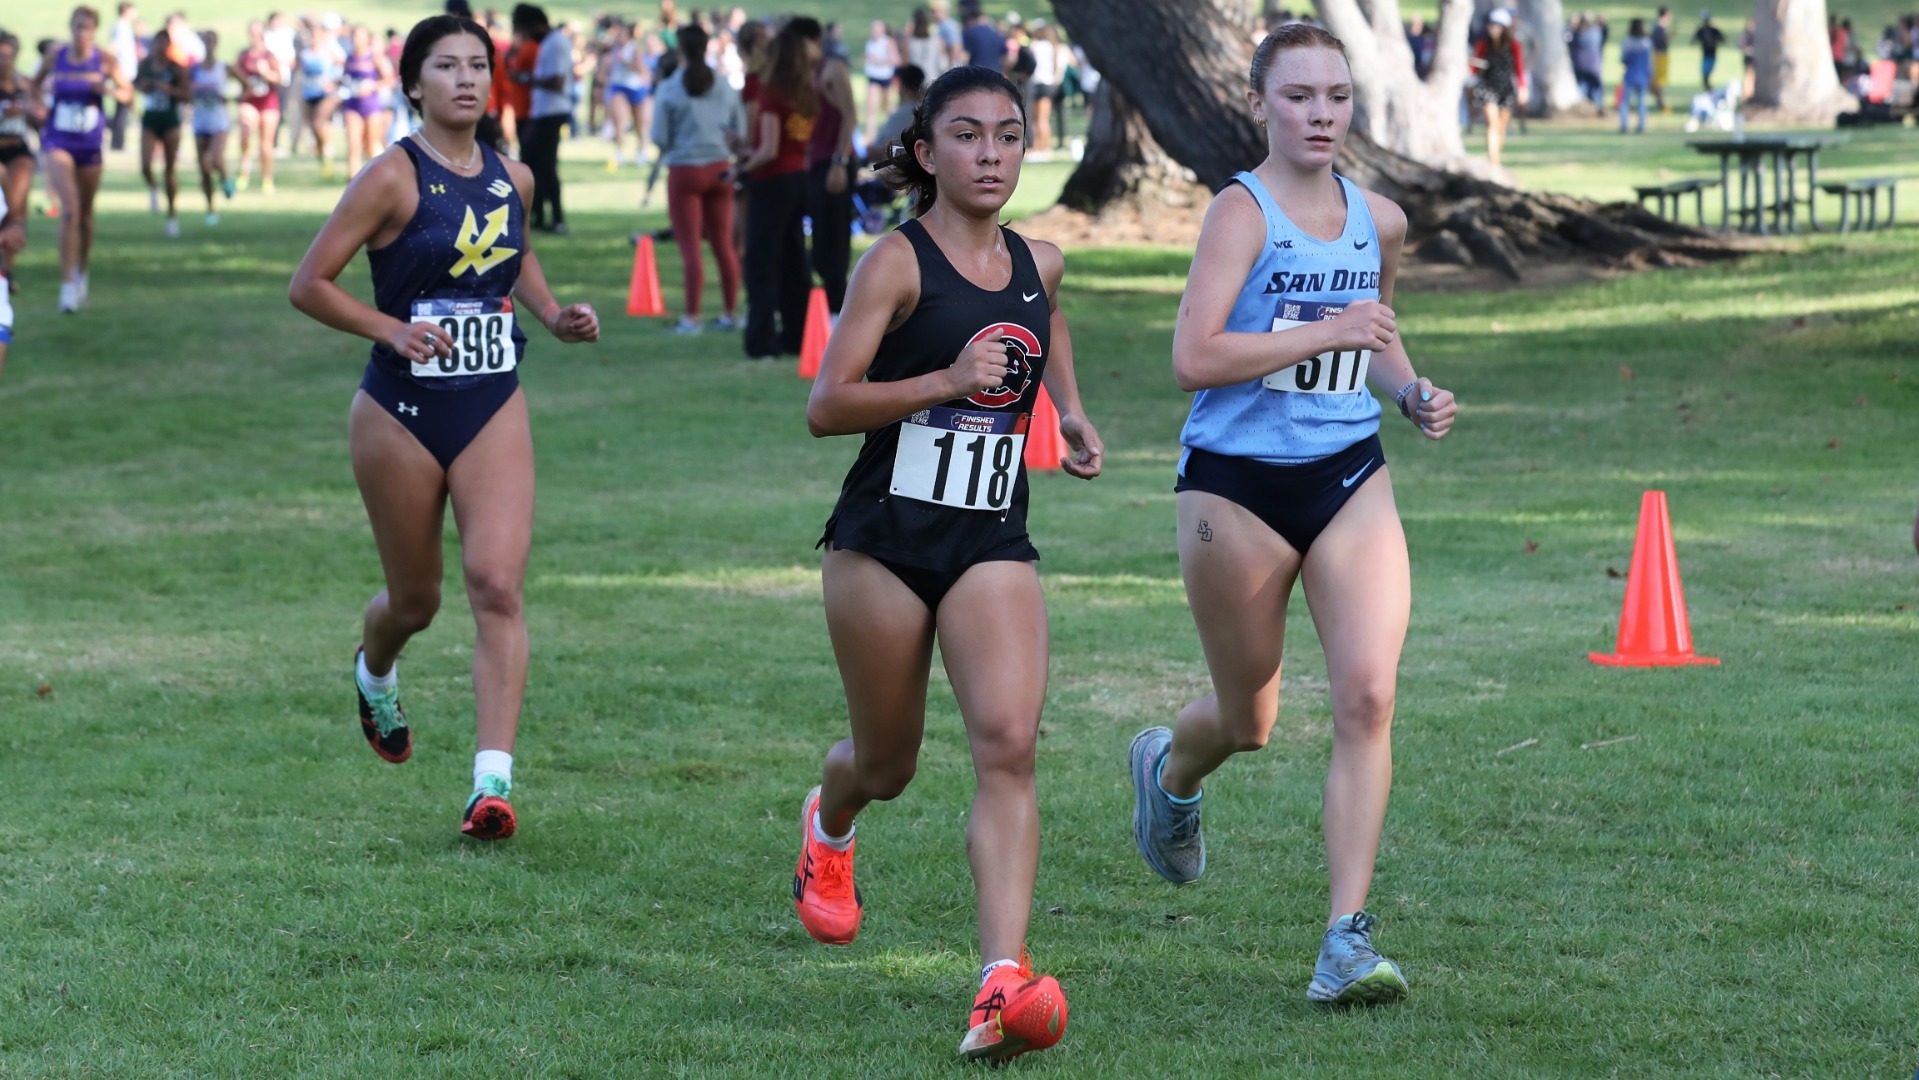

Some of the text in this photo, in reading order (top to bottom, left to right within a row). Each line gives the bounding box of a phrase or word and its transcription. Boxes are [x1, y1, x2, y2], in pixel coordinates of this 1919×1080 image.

[1273, 240, 1293, 249] WCC
[1263, 271, 1326, 294] SAN
[1325, 306, 1346, 314] FINIS
[961, 414, 994, 425] FINISHED
[957, 423, 993, 433] RESULTS
[932, 432, 1013, 508] 118
